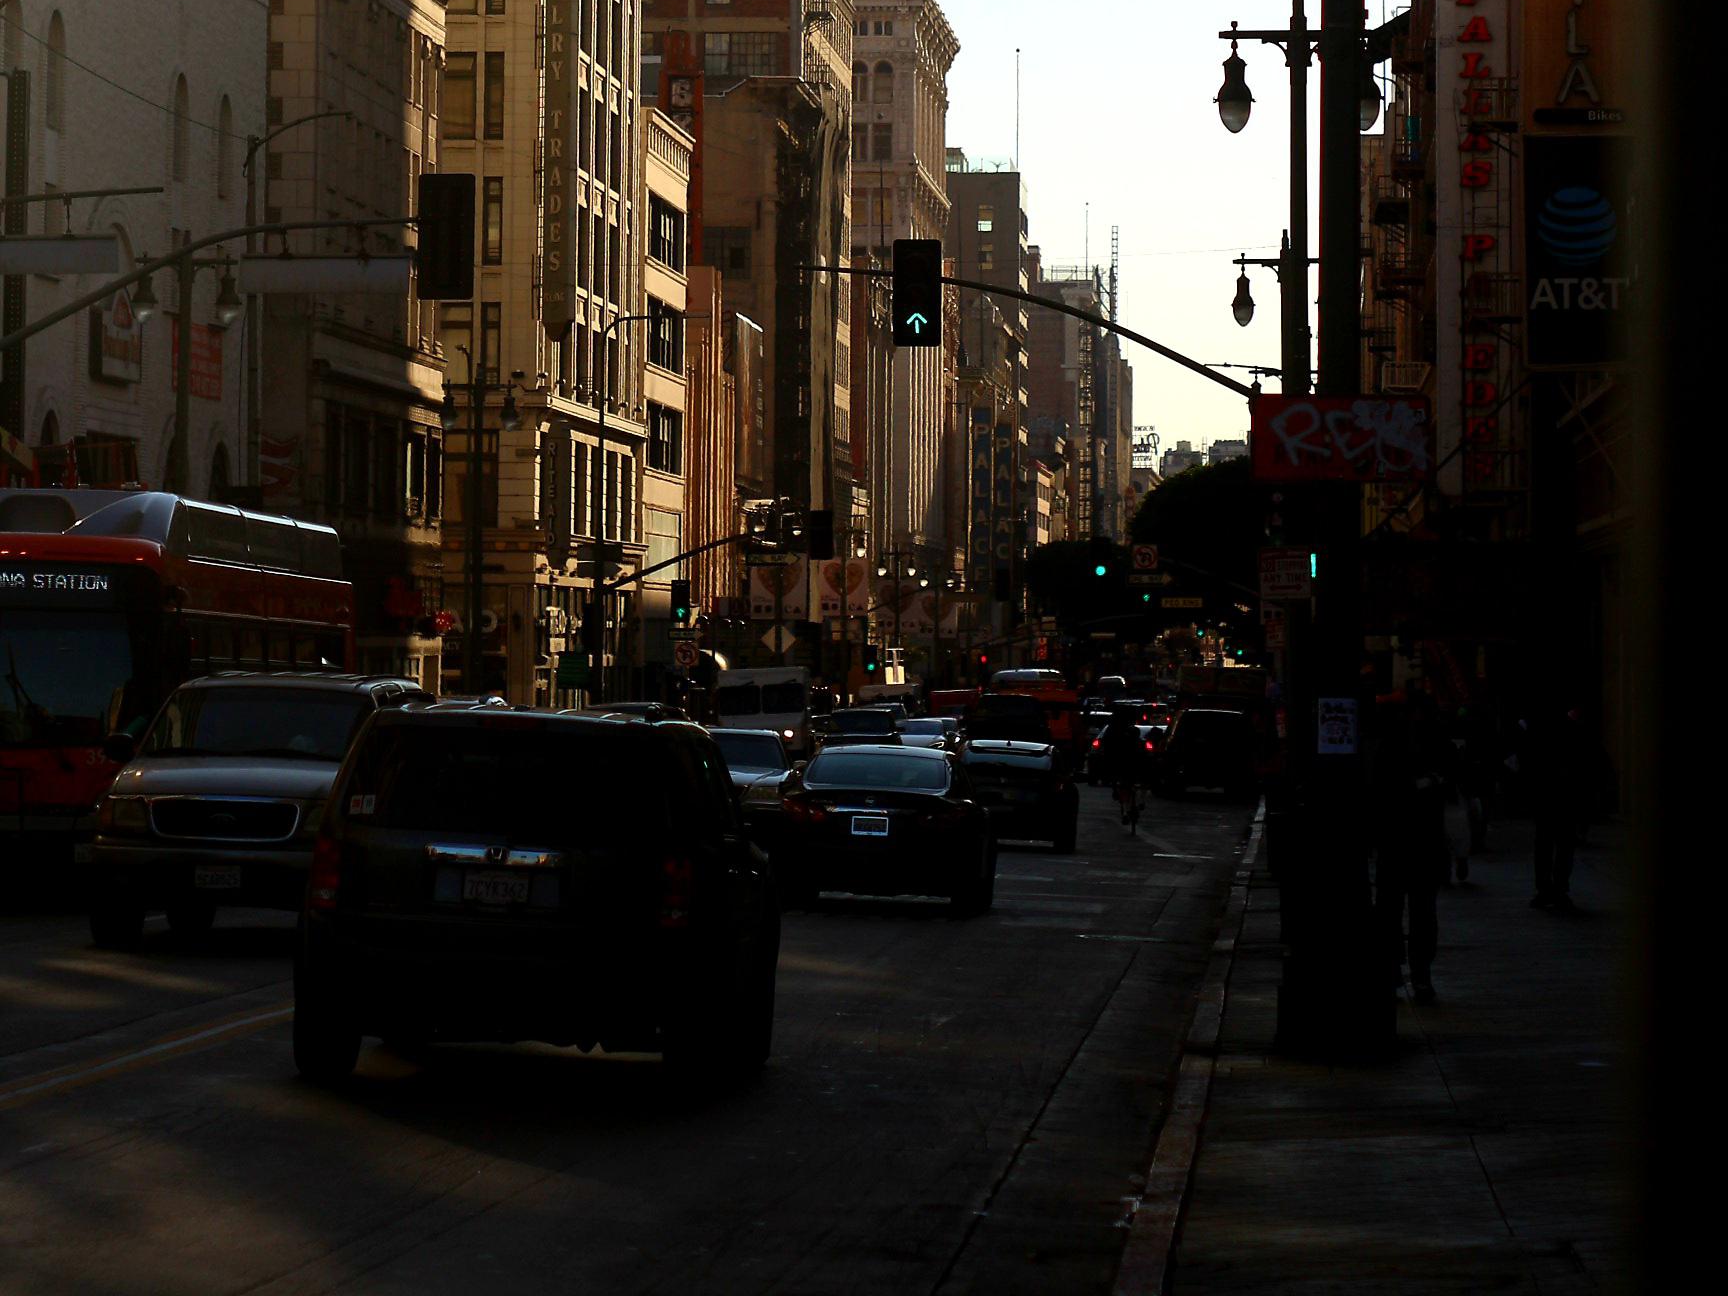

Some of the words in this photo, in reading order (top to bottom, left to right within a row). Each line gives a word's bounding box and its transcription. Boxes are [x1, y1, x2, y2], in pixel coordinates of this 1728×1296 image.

[548, 110, 564, 272] TRADES
[1529, 277, 1625, 311] AT&T
[1460, 234, 1498, 482] PEDES
[547, 442, 558, 498] RITE
[974, 423, 992, 582] PALACE
[0, 572, 26, 588] NA
[32, 573, 109, 591] STATION
